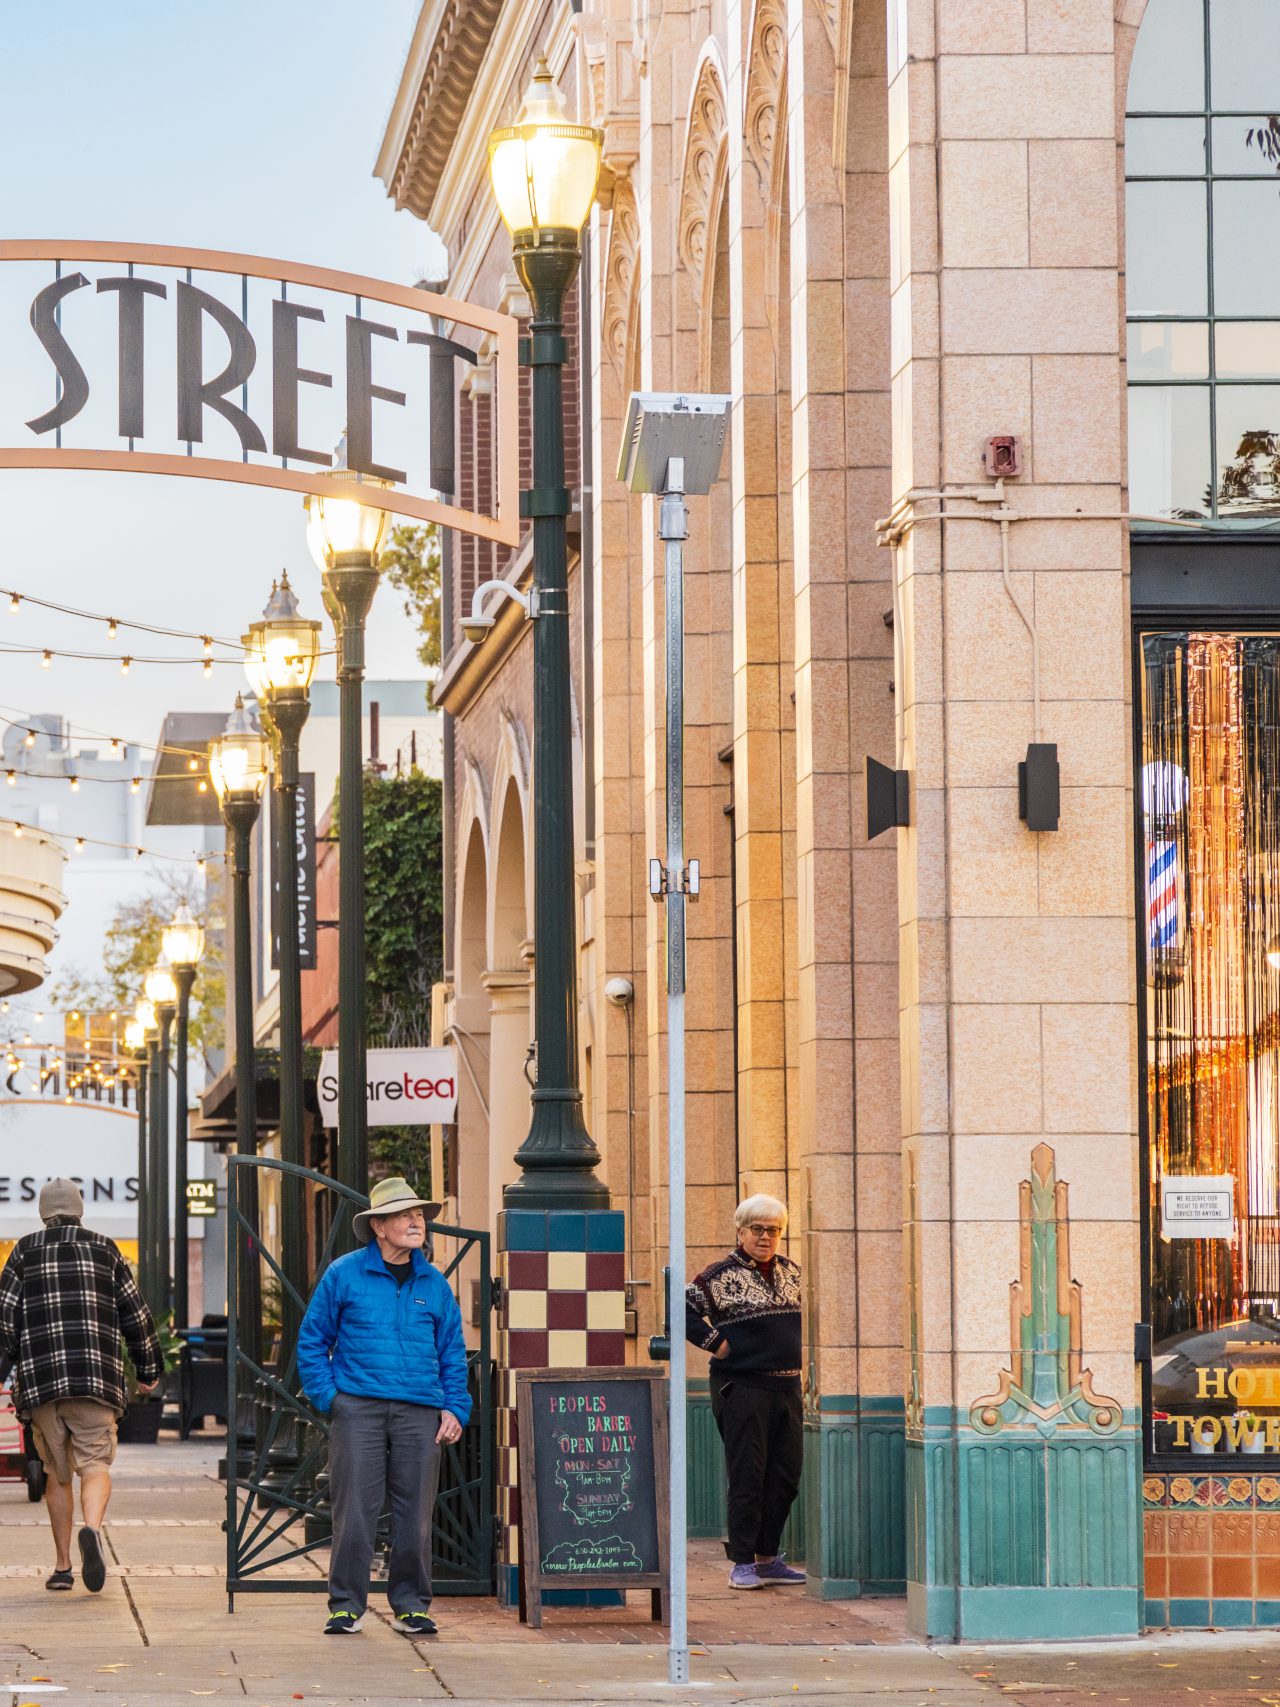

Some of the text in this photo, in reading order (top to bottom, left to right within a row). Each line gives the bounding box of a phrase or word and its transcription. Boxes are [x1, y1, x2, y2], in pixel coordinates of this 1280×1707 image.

[25, 272, 477, 494] STREET
[322, 1072, 454, 1102] Sretea
[1195, 1367, 1280, 1400] HOT
[549, 1396, 607, 1413] PEOPLES
[587, 1415, 632, 1432] BARBER
[560, 1435, 637, 1453] OPEN DAILY
